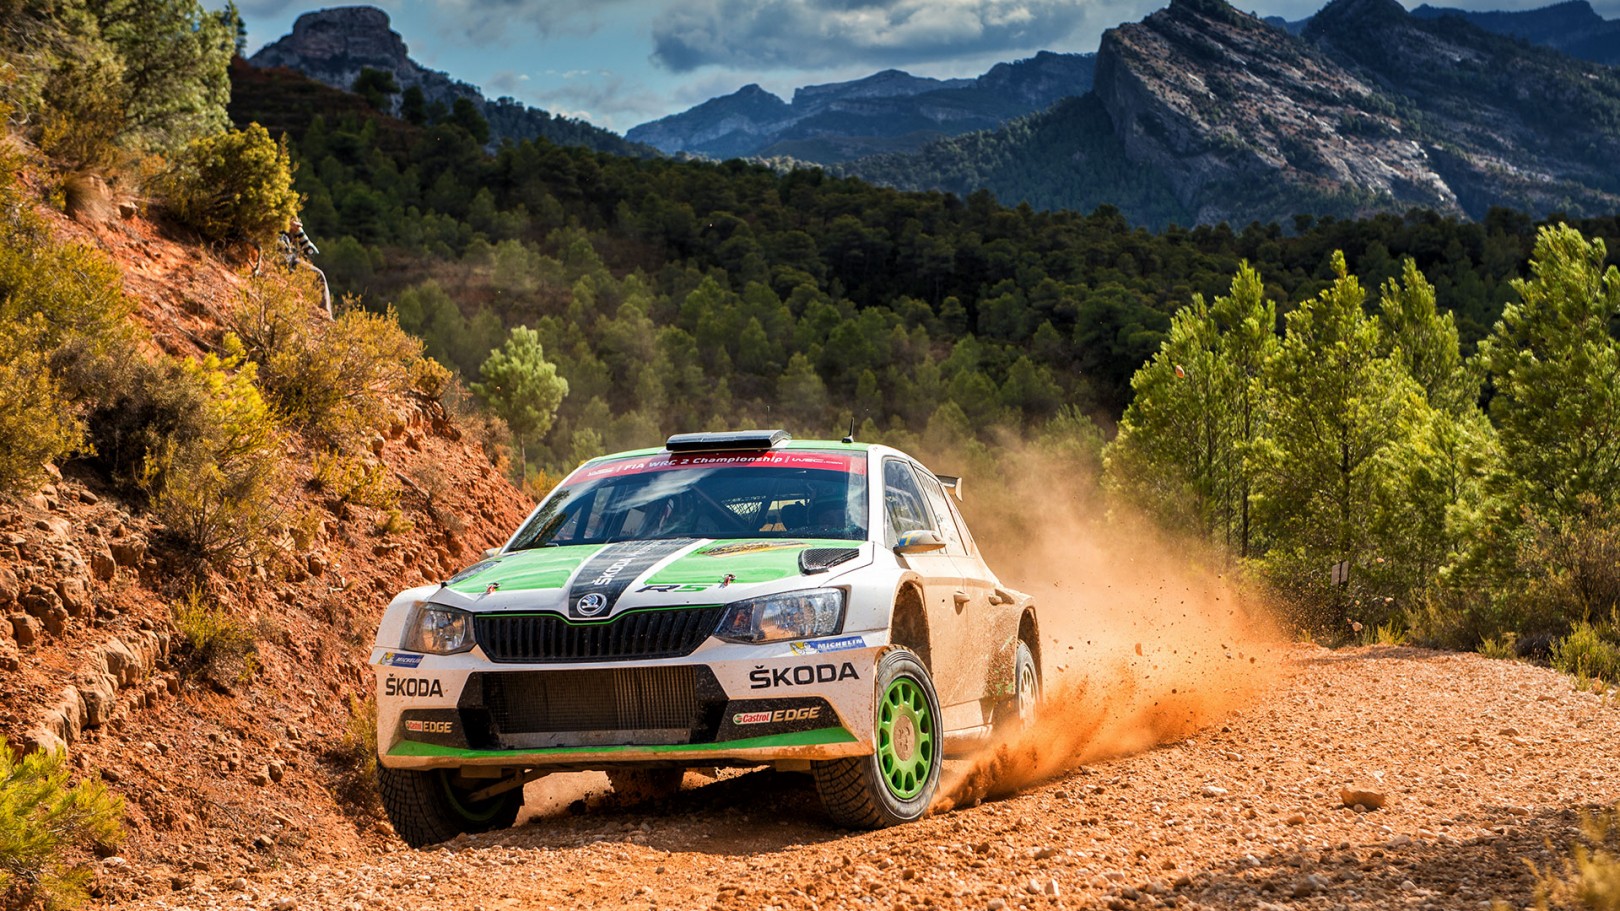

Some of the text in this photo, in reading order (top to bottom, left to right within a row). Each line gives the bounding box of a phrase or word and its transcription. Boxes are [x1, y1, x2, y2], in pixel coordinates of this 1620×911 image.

[623, 462, 645, 471] FIA
[649, 459, 678, 468] WRC
[692, 455, 783, 464] Championship
[634, 584, 714, 593] R5
[817, 638, 864, 650] MICHELIN
[750, 663, 859, 689] ŠKODA
[385, 674, 443, 697] ŠKODA
[742, 706, 822, 723] Castrol EDGE
[423, 721, 453, 734] EDGE
